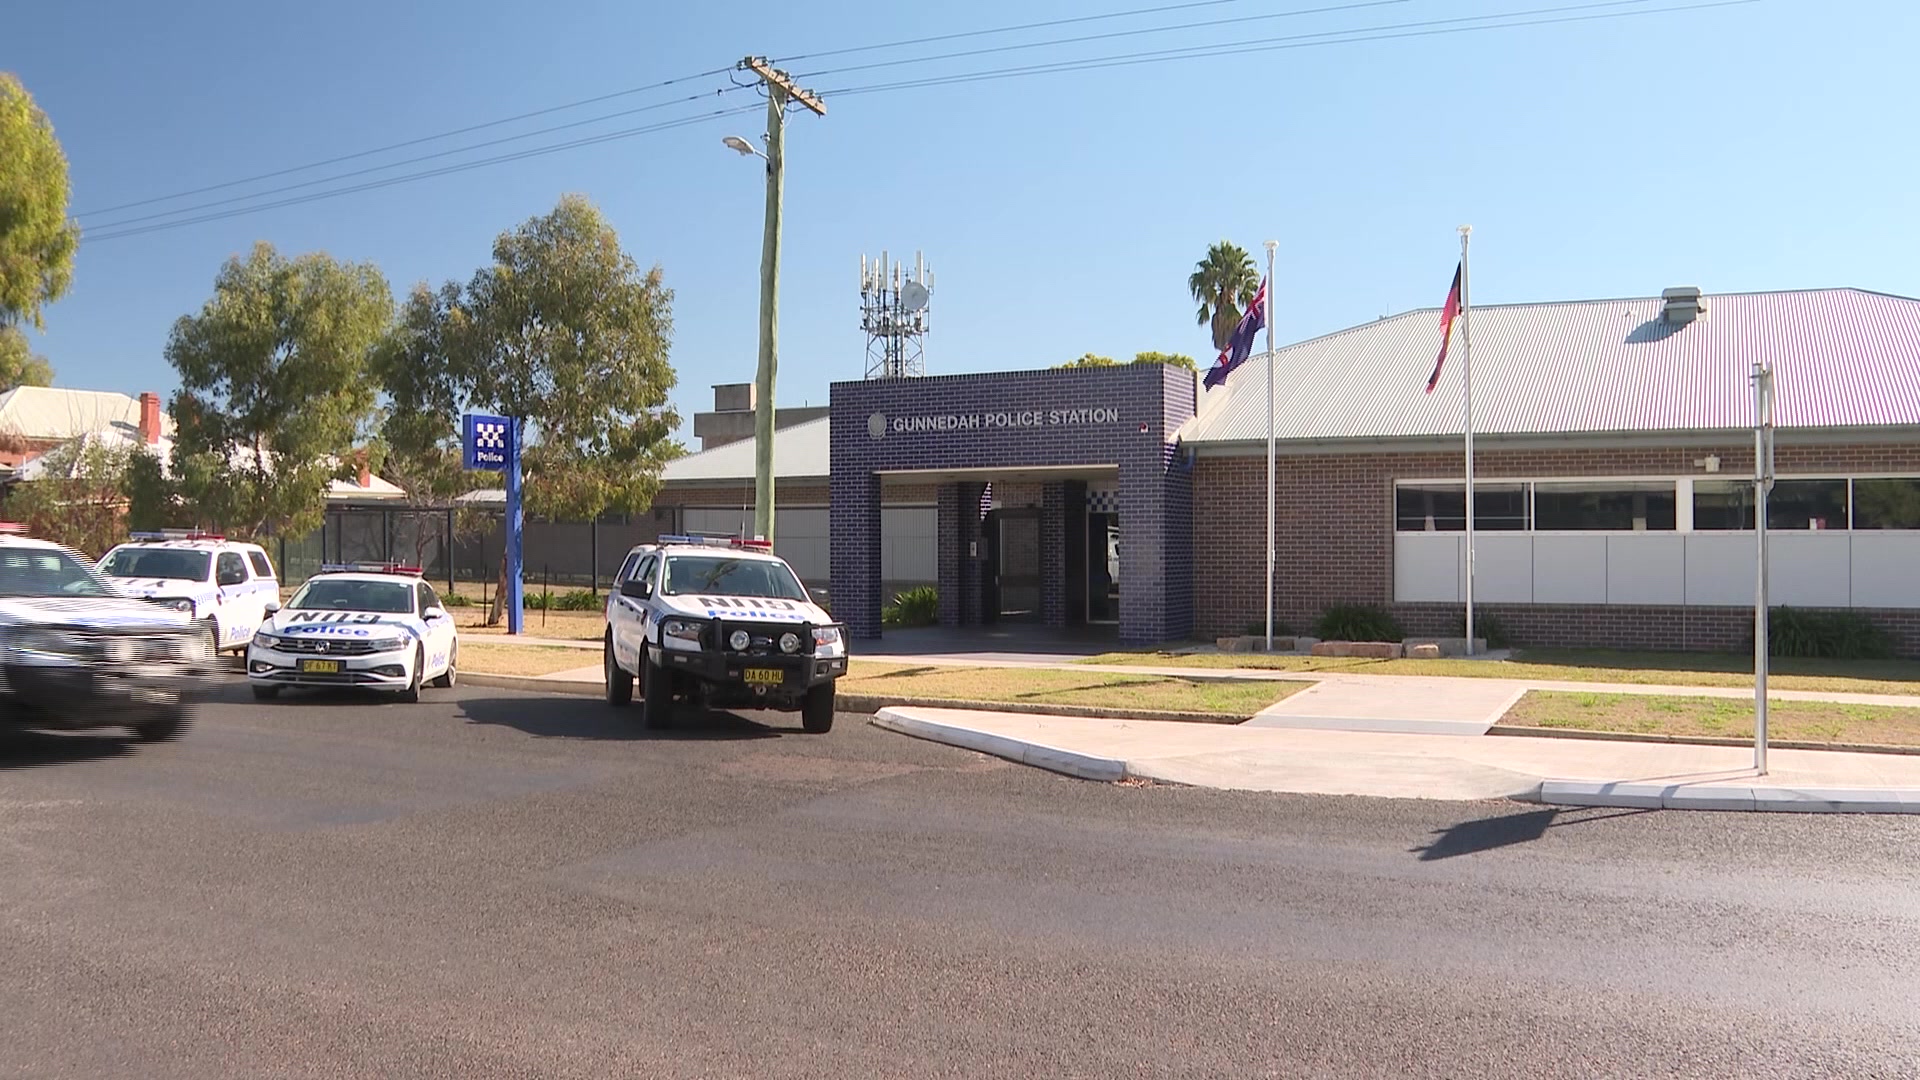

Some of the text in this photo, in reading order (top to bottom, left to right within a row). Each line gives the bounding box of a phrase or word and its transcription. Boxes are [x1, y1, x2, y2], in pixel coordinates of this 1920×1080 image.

[893, 408, 1119, 432] GUNNEDAH POLICE STATION
[477, 451, 504, 463] Police
[708, 610, 805, 620] Police
[283, 625, 369, 636] Police
[745, 670, 783, 681] DA 60 HU
